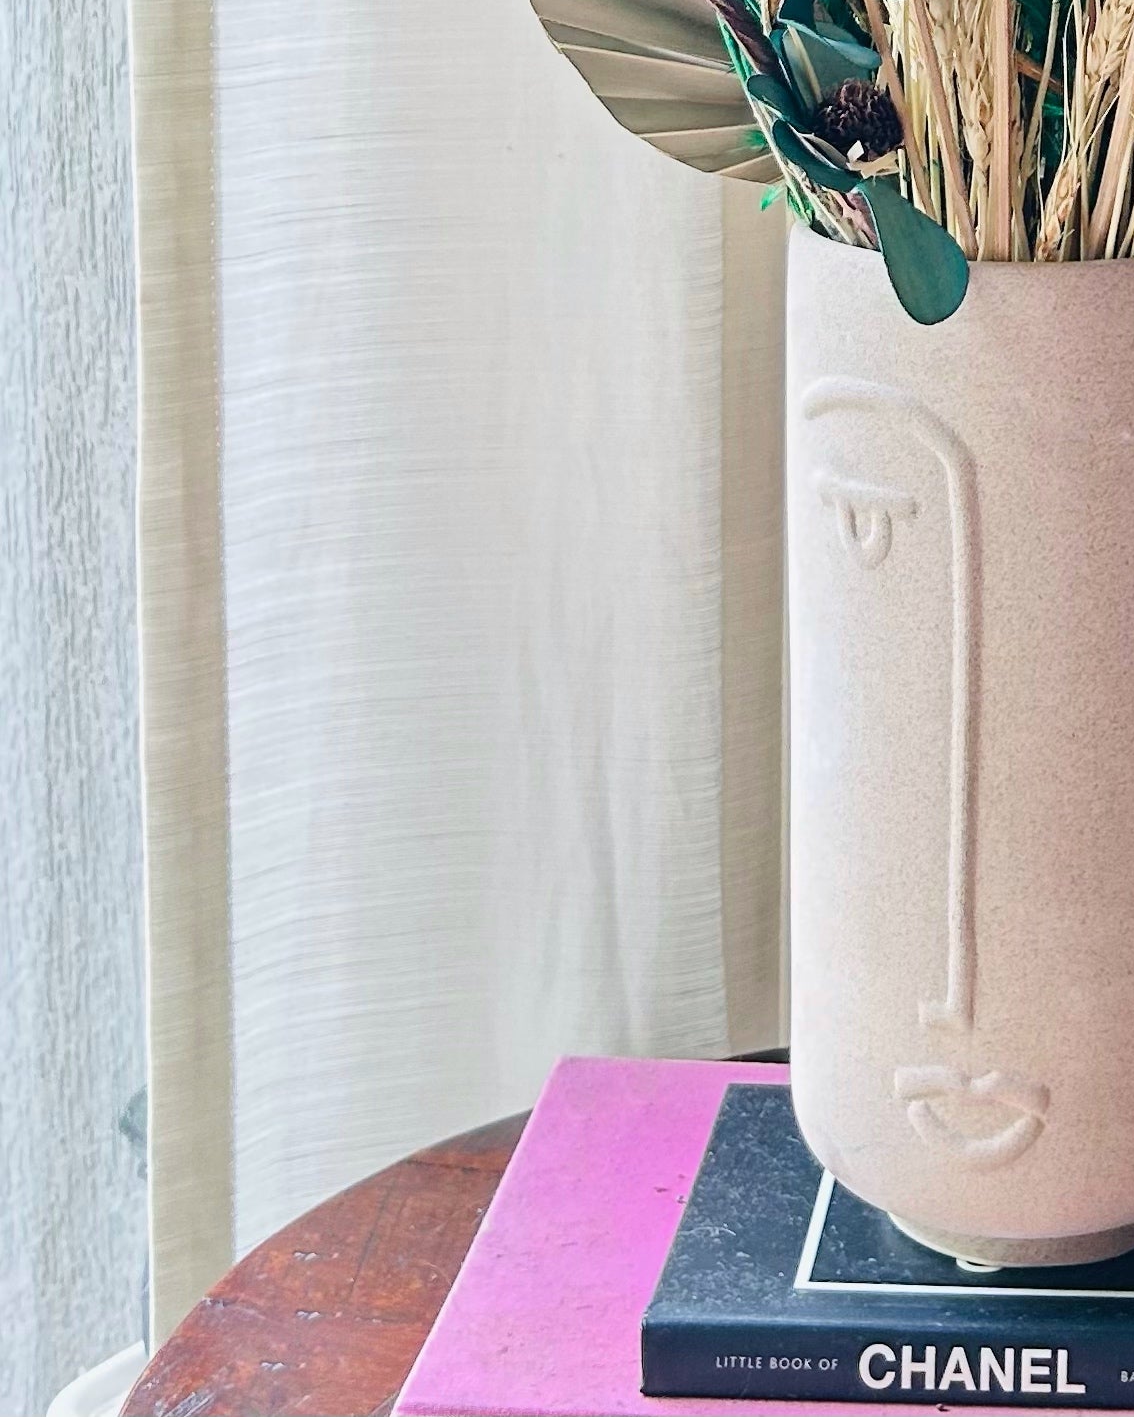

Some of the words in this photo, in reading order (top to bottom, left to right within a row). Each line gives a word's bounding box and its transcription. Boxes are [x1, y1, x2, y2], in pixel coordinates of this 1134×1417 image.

[716, 1356, 762, 1369] LITTLE
[769, 1357, 812, 1371] BOOK
[818, 1358, 839, 1371] OF
[858, 1343, 1087, 1394] CHANEL
